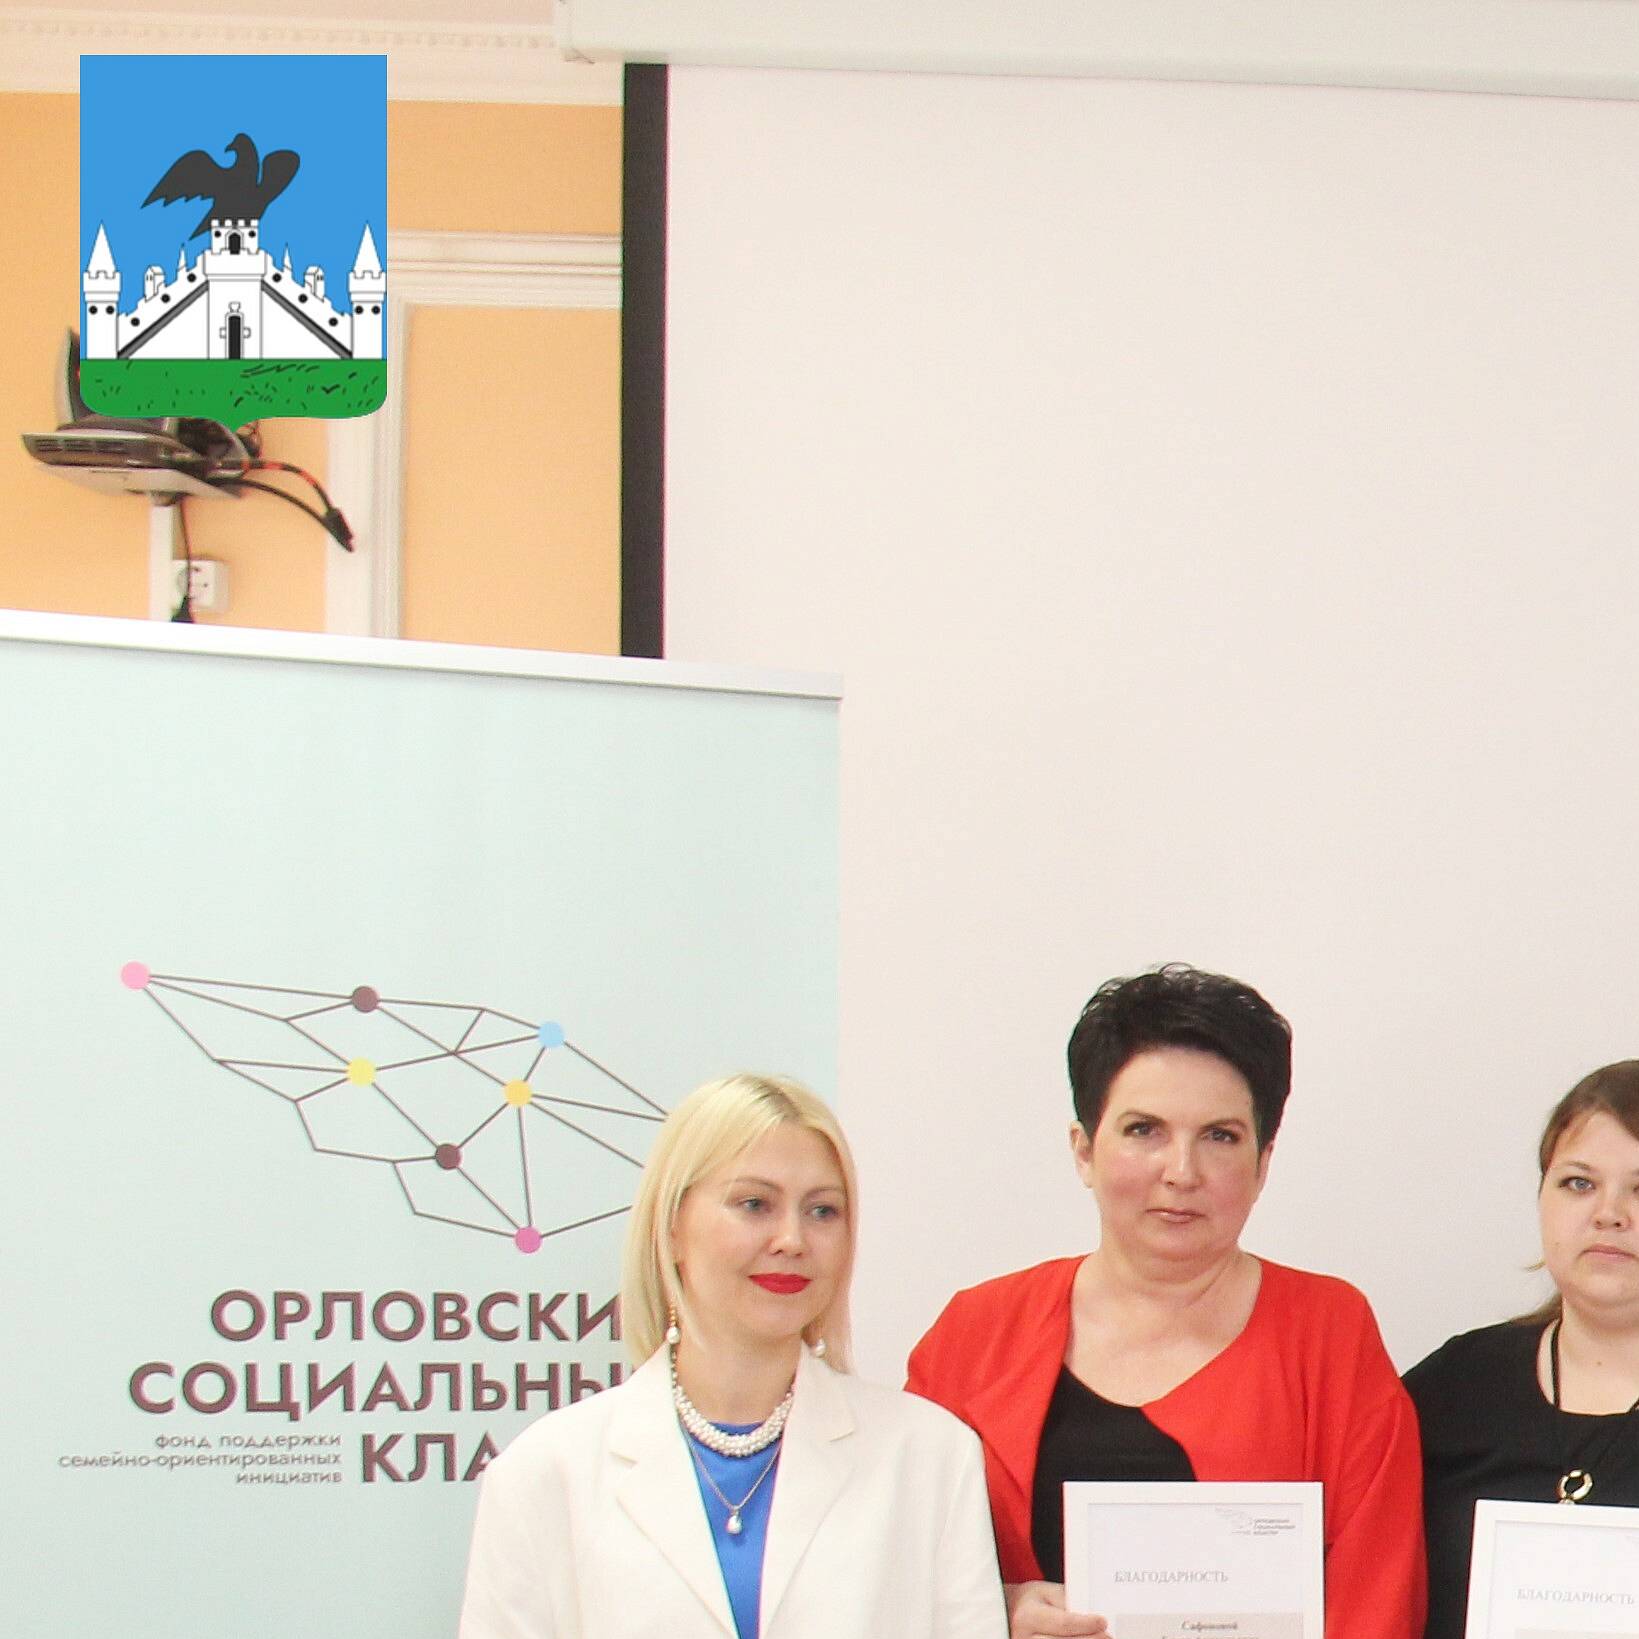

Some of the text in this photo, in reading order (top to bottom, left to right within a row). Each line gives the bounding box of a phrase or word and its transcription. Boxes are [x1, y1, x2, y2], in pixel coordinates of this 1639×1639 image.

[210, 1288, 623, 1343] ОРЛОВСКИ
[128, 1361, 625, 1422] СОЦИАЛЬНЫ
[155, 1433, 342, 1450] фонд поддержки
[58, 1451, 342, 1472] семейно-ориентированных
[362, 1432, 500, 1483] КЛА
[235, 1471, 343, 1486] инициатив
[1113, 1570, 1229, 1584] БЛАГОДАРНОСТЬ
